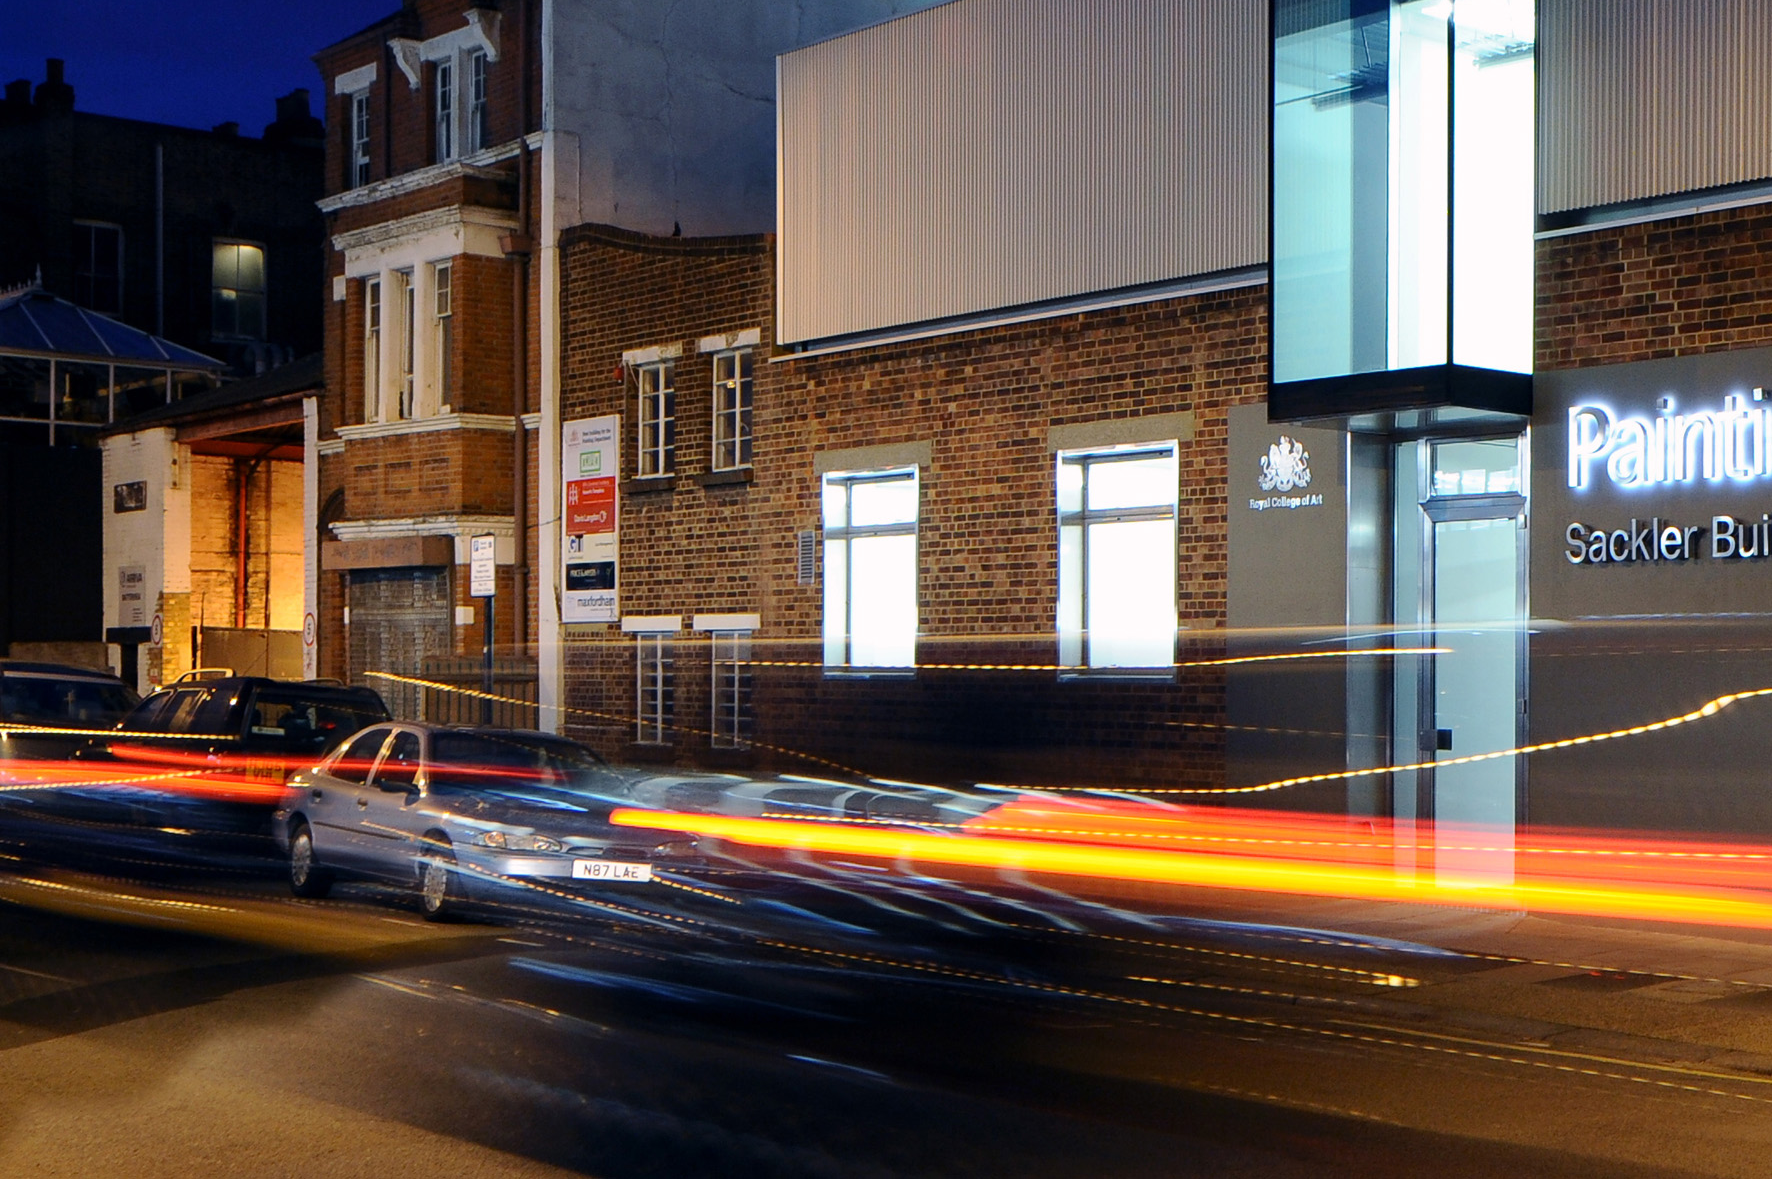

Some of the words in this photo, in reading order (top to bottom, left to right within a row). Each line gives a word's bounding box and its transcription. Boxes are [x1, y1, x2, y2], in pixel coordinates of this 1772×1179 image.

[1249, 498, 1271, 511] Royal
[1271, 495, 1301, 509] College
[1301, 494, 1310, 506] of
[1310, 494, 1323, 505] Art
[1565, 517, 1698, 565] Sackler
[583, 863, 611, 877] N87
